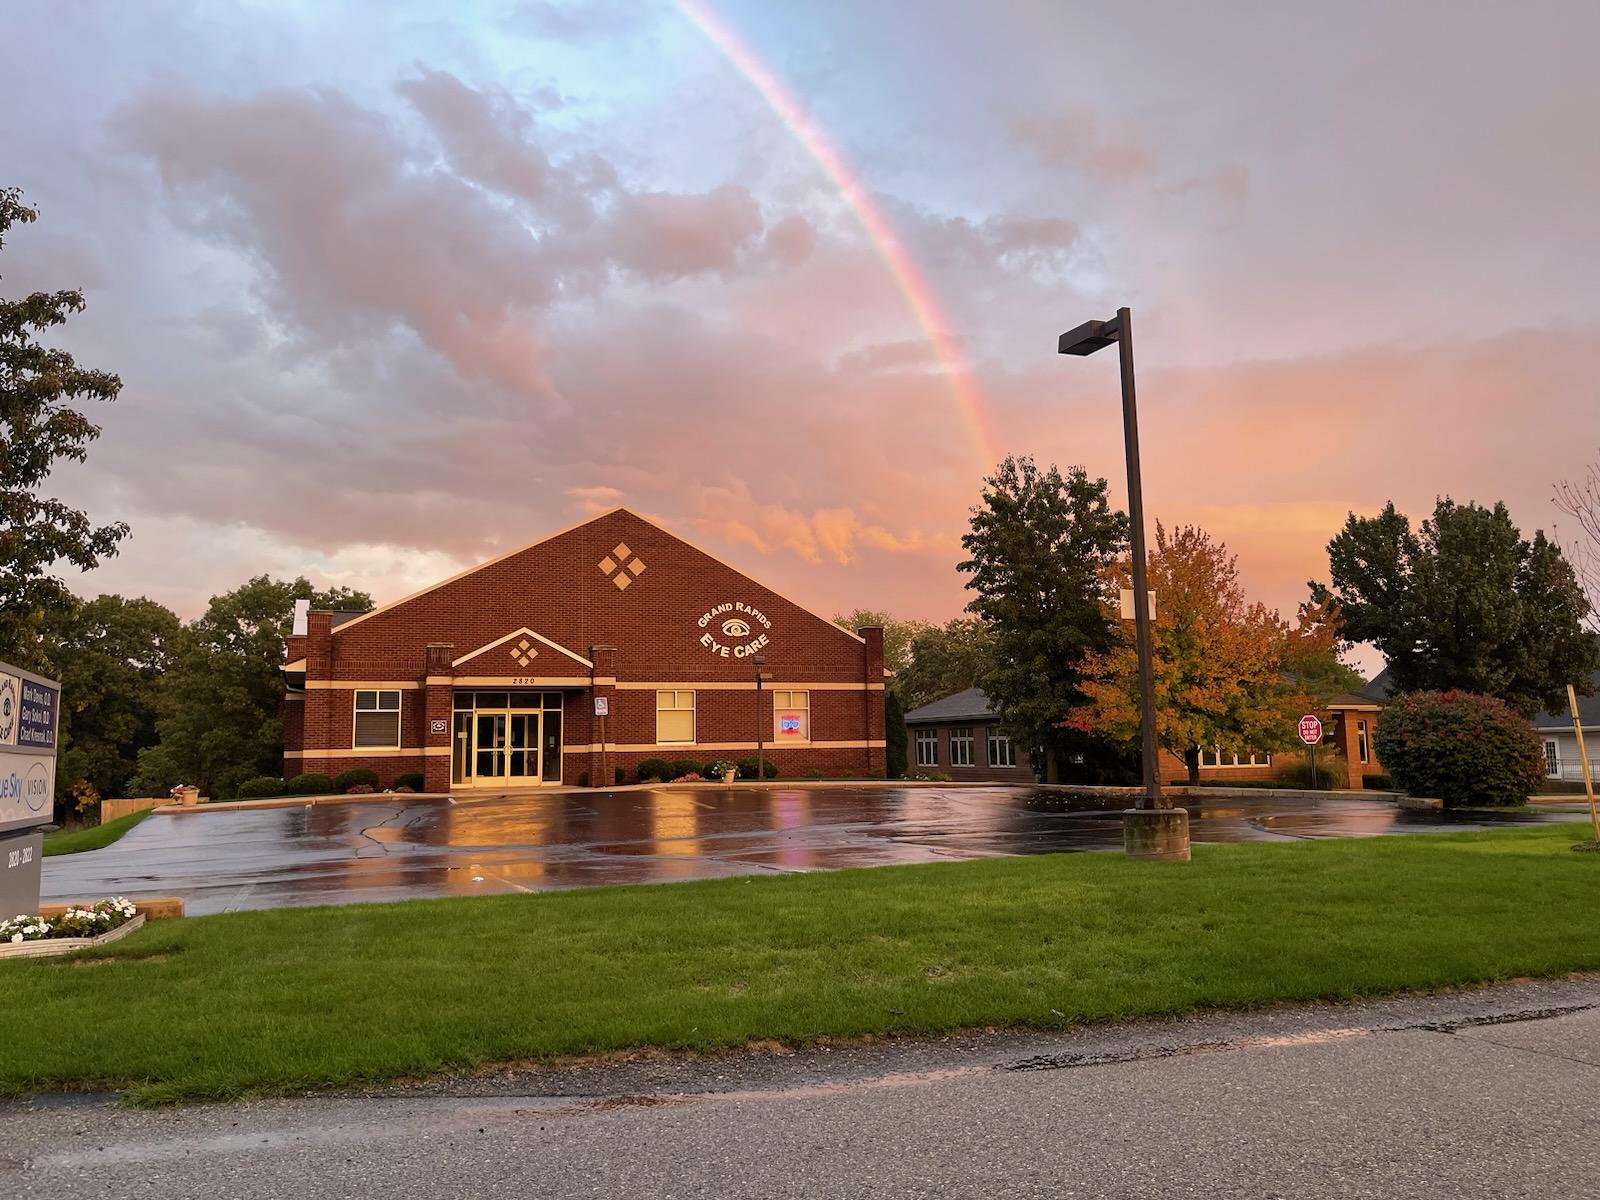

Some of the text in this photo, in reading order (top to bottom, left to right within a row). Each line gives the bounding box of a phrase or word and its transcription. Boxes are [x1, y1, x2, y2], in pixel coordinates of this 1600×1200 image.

[697, 601, 772, 629] GRAND RAPIDS
[700, 632, 770, 658] EYE CARE
[23, 685, 33, 701] Mark
[22, 705, 31, 725] Gary
[1301, 721, 1318, 729] STOP
[9, 773, 23, 804] Sky
[27, 779, 47, 796] VISION
[8, 850, 20, 868] 2820
[22, 846, 33, 865] 2822
